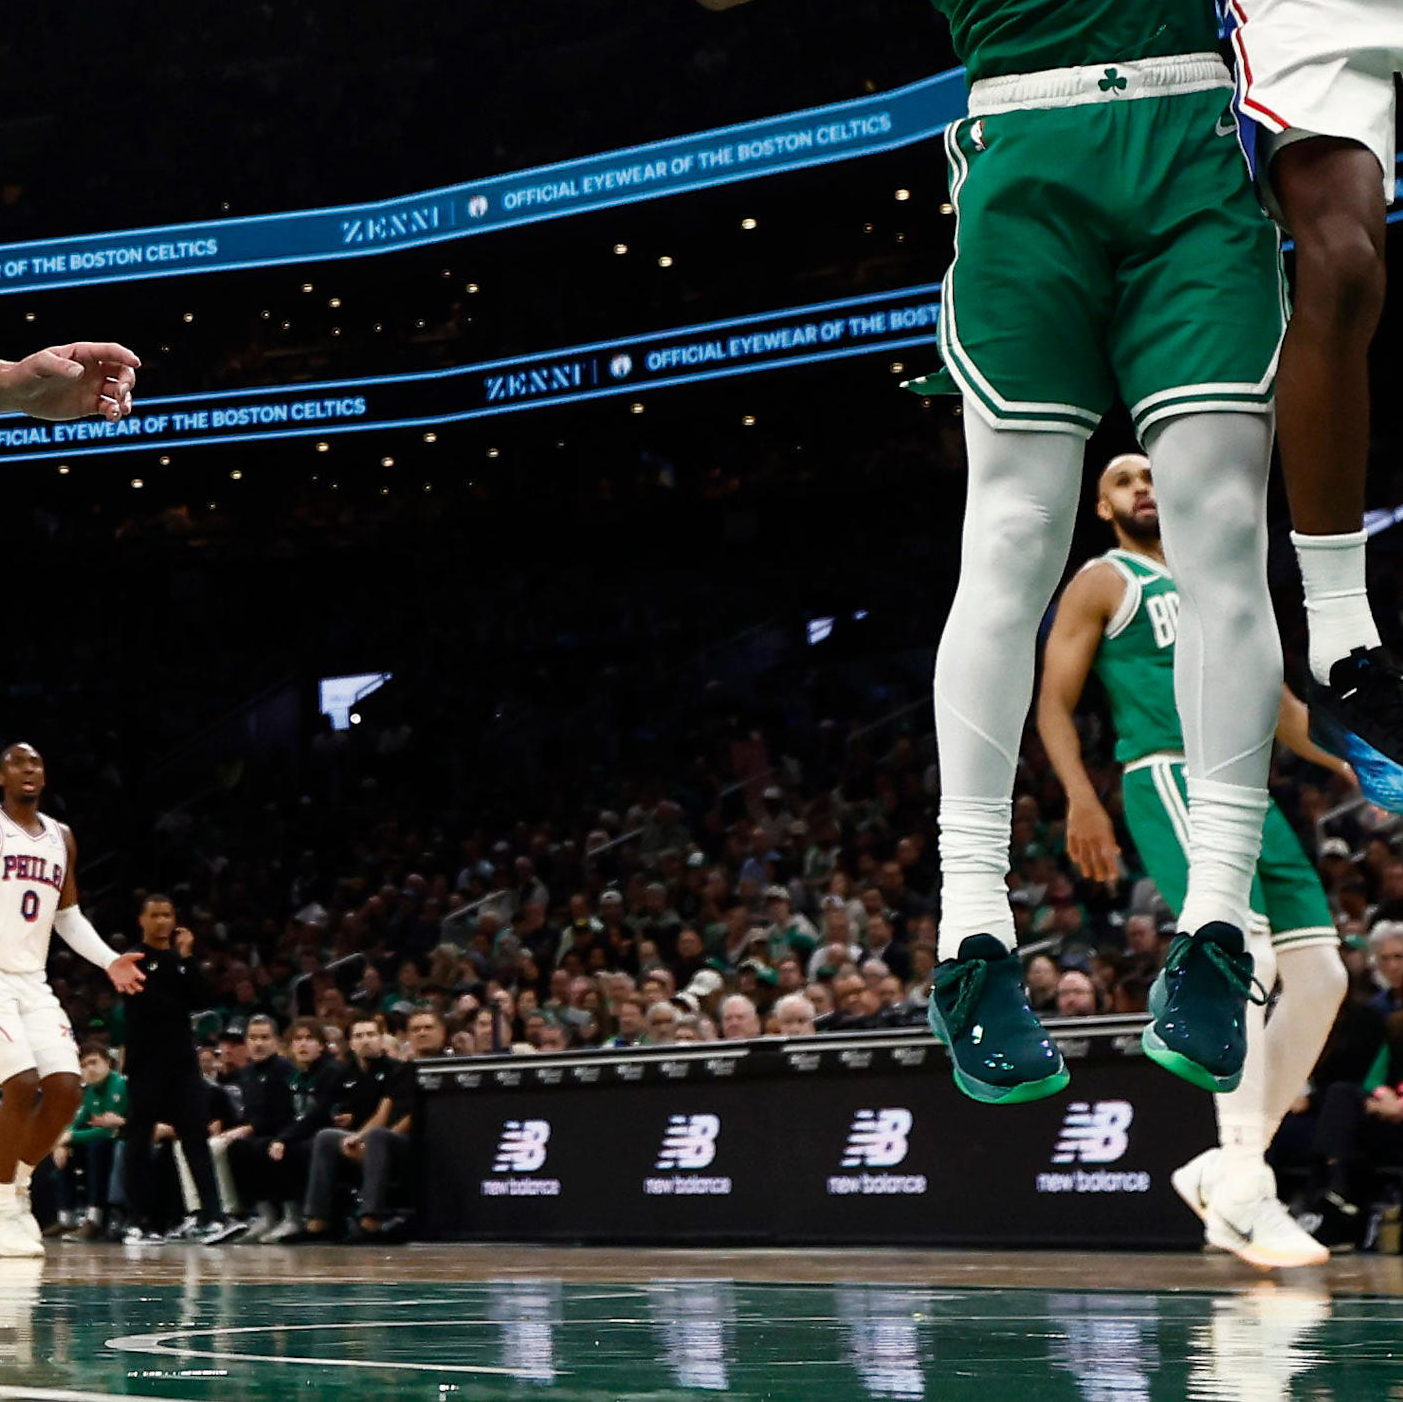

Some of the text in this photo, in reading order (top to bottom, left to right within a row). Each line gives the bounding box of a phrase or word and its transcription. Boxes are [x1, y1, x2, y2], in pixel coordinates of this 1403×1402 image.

[339, 111, 892, 243] ZENNI OFFICIAL EYEWEAR OF THE BOSTON CELTICS
[4, 255, 28, 277] OF
[31, 255, 67, 274] THE
[70, 246, 142, 271] BOSTON
[145, 239, 218, 263] CELTICS
[484, 300, 941, 402] ZENNI OFFICIAL EYEWEAR OF THE BOST
[53, 415, 142, 446] EYEWEAR
[144, 412, 168, 433] OF
[171, 409, 209, 430] THE
[211, 401, 288, 427] BOSTON
[290, 395, 366, 419] CELTICS
[2, 855, 64, 889] PHILA
[19, 888, 40, 923] 0
[675, 1176, 732, 1195] balance
[863, 1172, 928, 1195] balance
[1036, 1171, 1150, 1193] new balance
